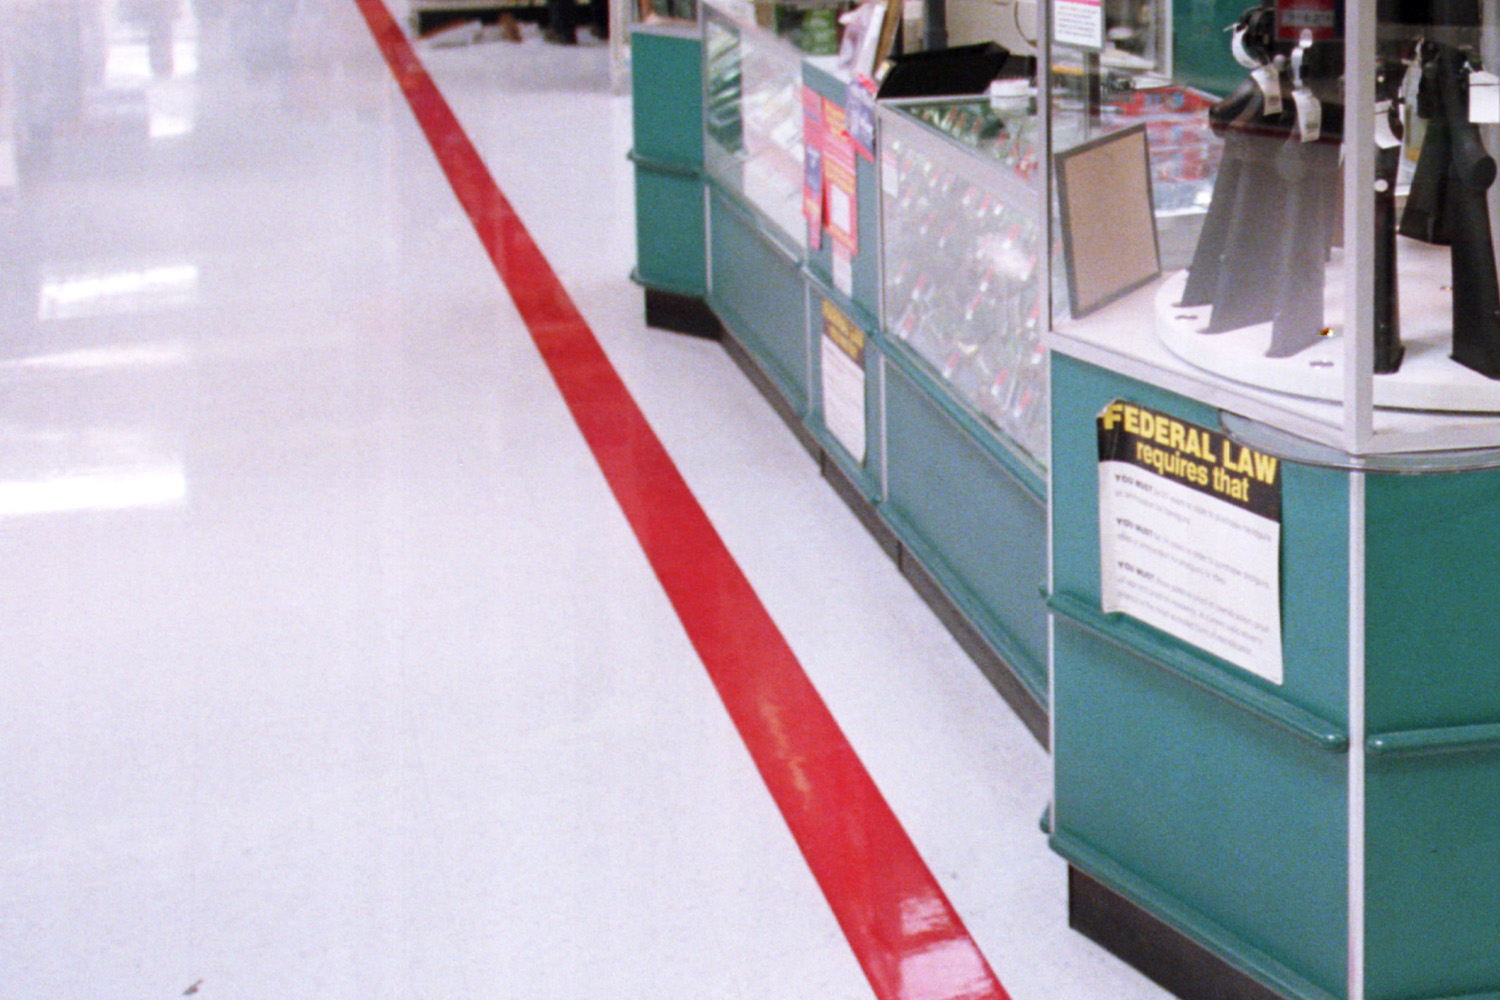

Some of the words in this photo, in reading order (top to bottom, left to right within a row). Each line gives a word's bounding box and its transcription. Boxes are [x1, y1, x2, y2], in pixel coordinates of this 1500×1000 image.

[1103, 403, 1217, 463] FEDERAL
[1222, 440, 1277, 485] LAW
[1136, 441, 1209, 486] requires
[1212, 466, 1250, 502] that
